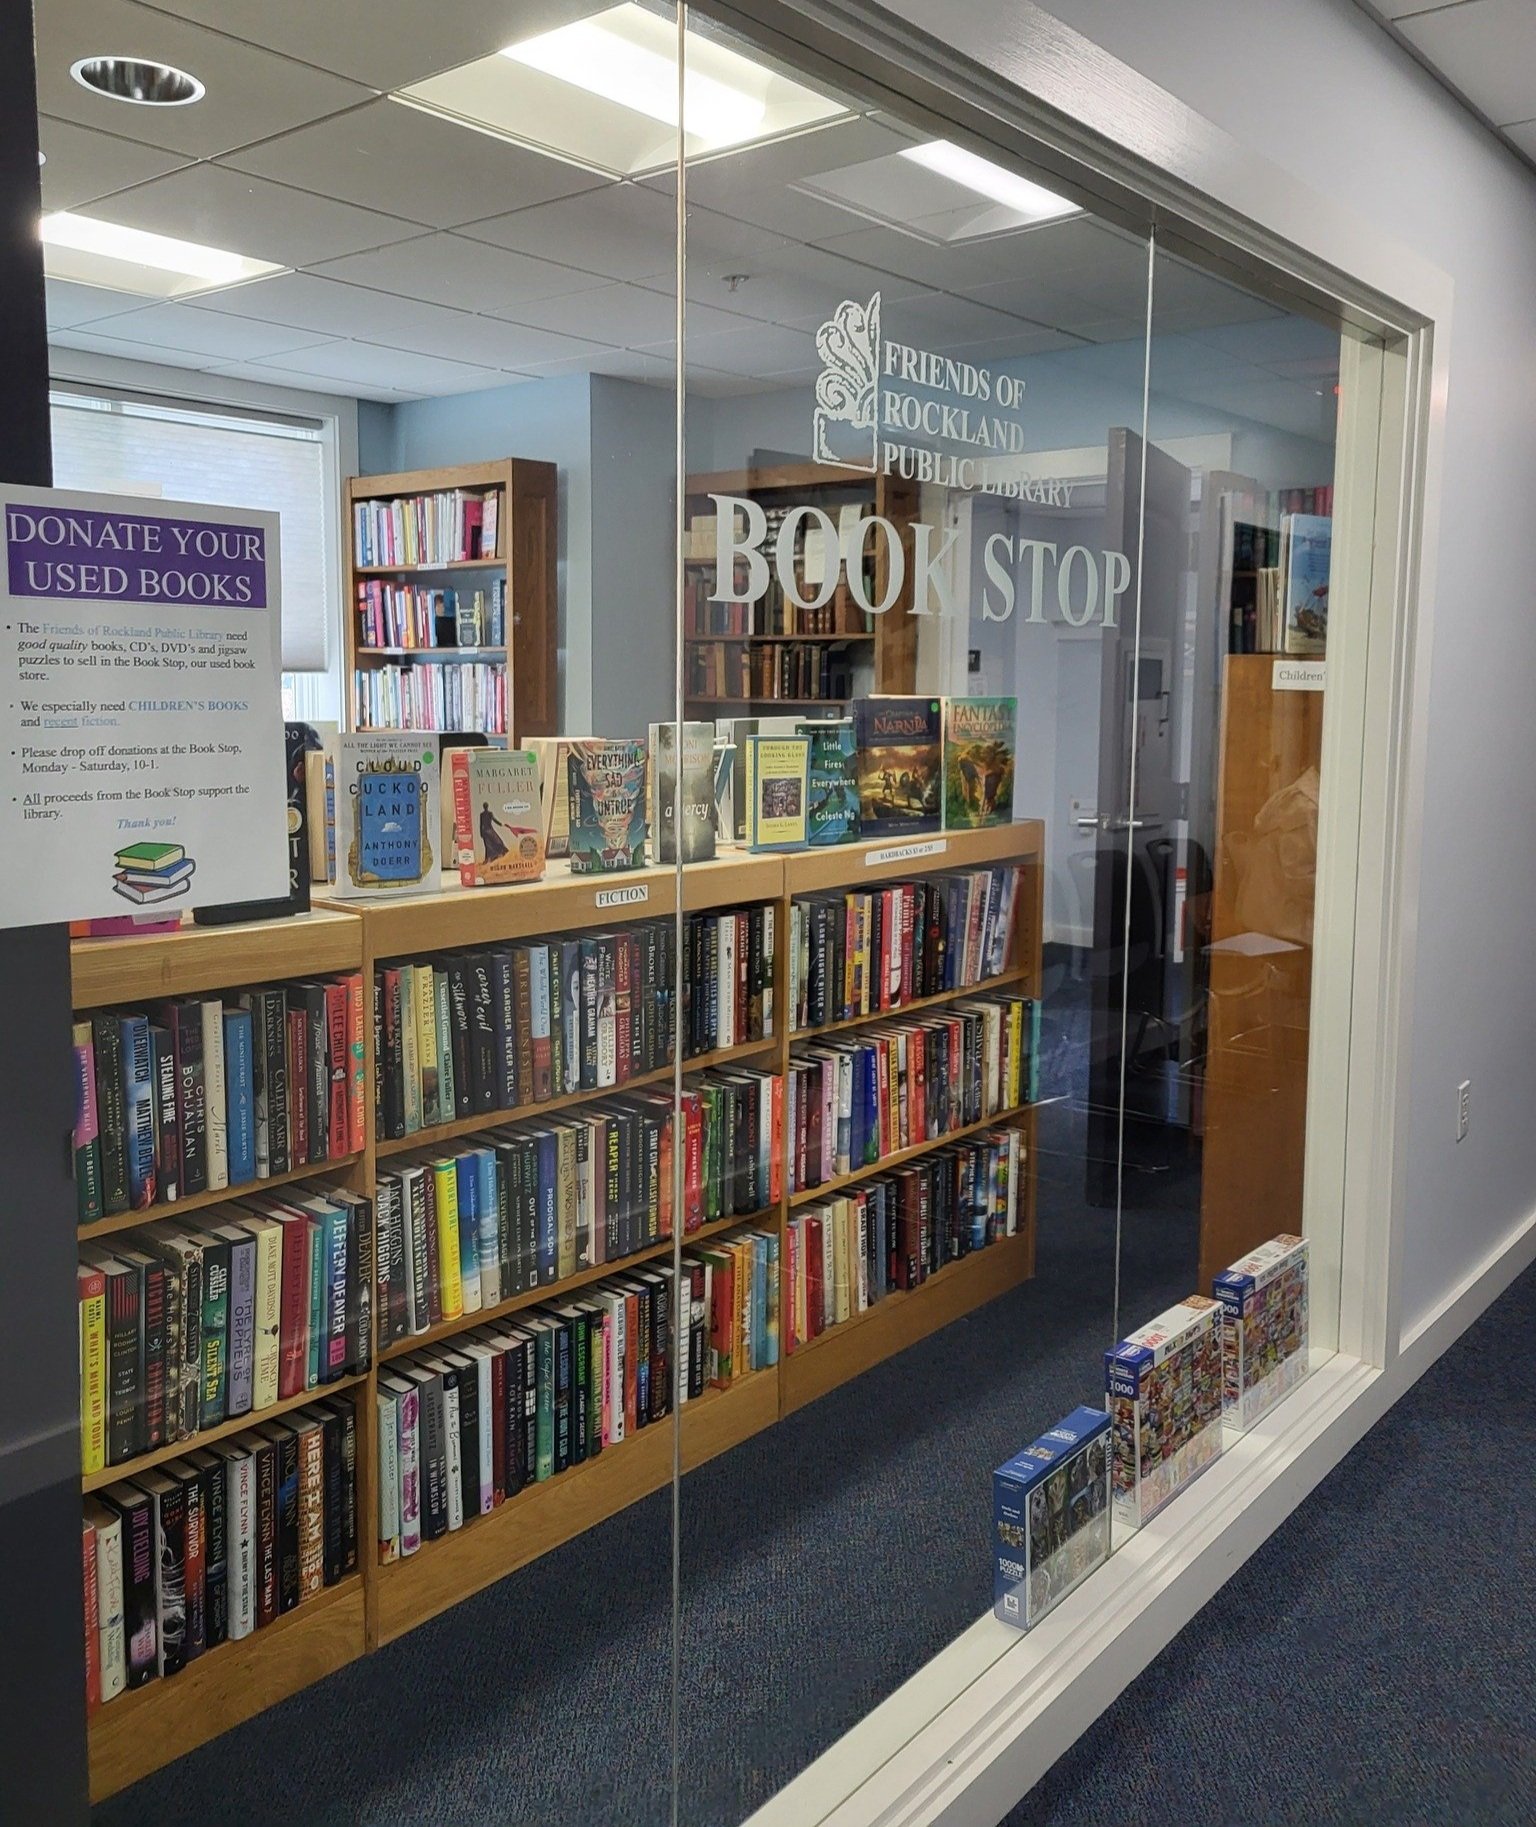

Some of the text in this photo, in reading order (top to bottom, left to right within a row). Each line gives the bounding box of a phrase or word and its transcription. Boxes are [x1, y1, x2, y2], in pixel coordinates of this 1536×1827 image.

[884, 340, 1026, 410] FRIENDS OF
[883, 392, 1024, 454] ROCKLAND
[883, 442, 1074, 509] PUBLIC LIBRARY
[8, 513, 265, 561] DONATE YOUR
[707, 494, 1131, 628] BOOK STOP
[25, 561, 251, 602] USED BOOKS
[18, 623, 247, 642] The Friends of Rockland Public Library need
[18, 640, 247, 656] good quality books, CD's, DVD's and jigsaw
[19, 655, 60, 667] puzzles
[63, 657, 74, 665] to
[78, 656, 97, 666] sell
[101, 657, 110, 666] in
[114, 656, 130, 666] the
[133, 657, 159, 667] Book
[163, 659, 188, 670] Stop,
[210, 660, 231, 669] used
[233, 660, 255, 669] book
[19, 671, 49, 681] store.
[1279, 671, 1327, 681] Children'
[21, 701, 248, 713] We especially need CHILDREN'S BOOKS
[21, 716, 120, 728] and recent fiction.
[874, 717, 928, 735] NARNIA
[22, 744, 242, 759] Please drop off donations at the Book Stop,
[823, 742, 841, 750] Little
[22, 760, 158, 774] Monday Saturday, 10-1.
[356, 761, 421, 772] CLOUD
[477, 768, 533, 777] MARGARET
[587, 755, 640, 770] EVERYTHING
[825, 760, 842, 768] Fires
[349, 783, 428, 794] CUCKOO
[478, 781, 534, 794] FULLER
[605, 773, 622, 788] SAD
[812, 778, 855, 788] Everywhere
[23, 785, 250, 805] All proceeds from the Book Stop support the
[455, 780, 466, 832] FULLER
[24, 808, 62, 820] library.
[366, 804, 414, 816] LAND
[599, 799, 632, 816] UNTRUE
[665, 803, 709, 820] a ercy
[816, 810, 855, 821] Celeste Ng
[117, 817, 176, 829] Thank you!
[365, 841, 417, 850] ANTHONY
[373, 857, 410, 866] DOERR
[599, 887, 647, 905] FICTION
[648, 946, 656, 983] BROKER
[475, 968, 491, 1005] career
[451, 982, 468, 1030] Silkworm
[476, 1006, 493, 1032] evil
[502, 964, 514, 1093] LISA GARDNER NEVER TELL
[133, 1024, 150, 1083] OVERWATCH
[333, 1031, 345, 1063] CHILD
[160, 1055, 175, 1101] STEALING
[162, 1102, 175, 1124] FIRE
[183, 1067, 195, 1159] BOHJALIAN
[196, 1085, 205, 1134] CHRIS
[609, 1131, 618, 1172] REAPER
[546, 1188, 554, 1234] PRODIGAL
[377, 1194, 390, 1284] JACK HIGGINS
[209, 1264, 220, 1301] CUSSLER
[217, 1268, 227, 1294] CLIVE
[332, 1219, 346, 1335] JEFFERY DEAVER
[233, 1306, 244, 1381] ORPHEUS
[205, 1340, 220, 1401] SILENT SEA
[1110, 1380, 1134, 1395] 1000
[307, 1437, 321, 1540] HERE I AM
[429, 1458, 439, 1515] IN WILMSLOW
[240, 1463, 249, 1535] VINCE FLYNN
[187, 1484, 199, 1559] THE SURVIVOR
[132, 1507, 150, 1584] JOY FIELDING
[263, 1543, 273, 1605] THE LAST MAN
[1000, 1566, 1023, 1578] PUZZLE
